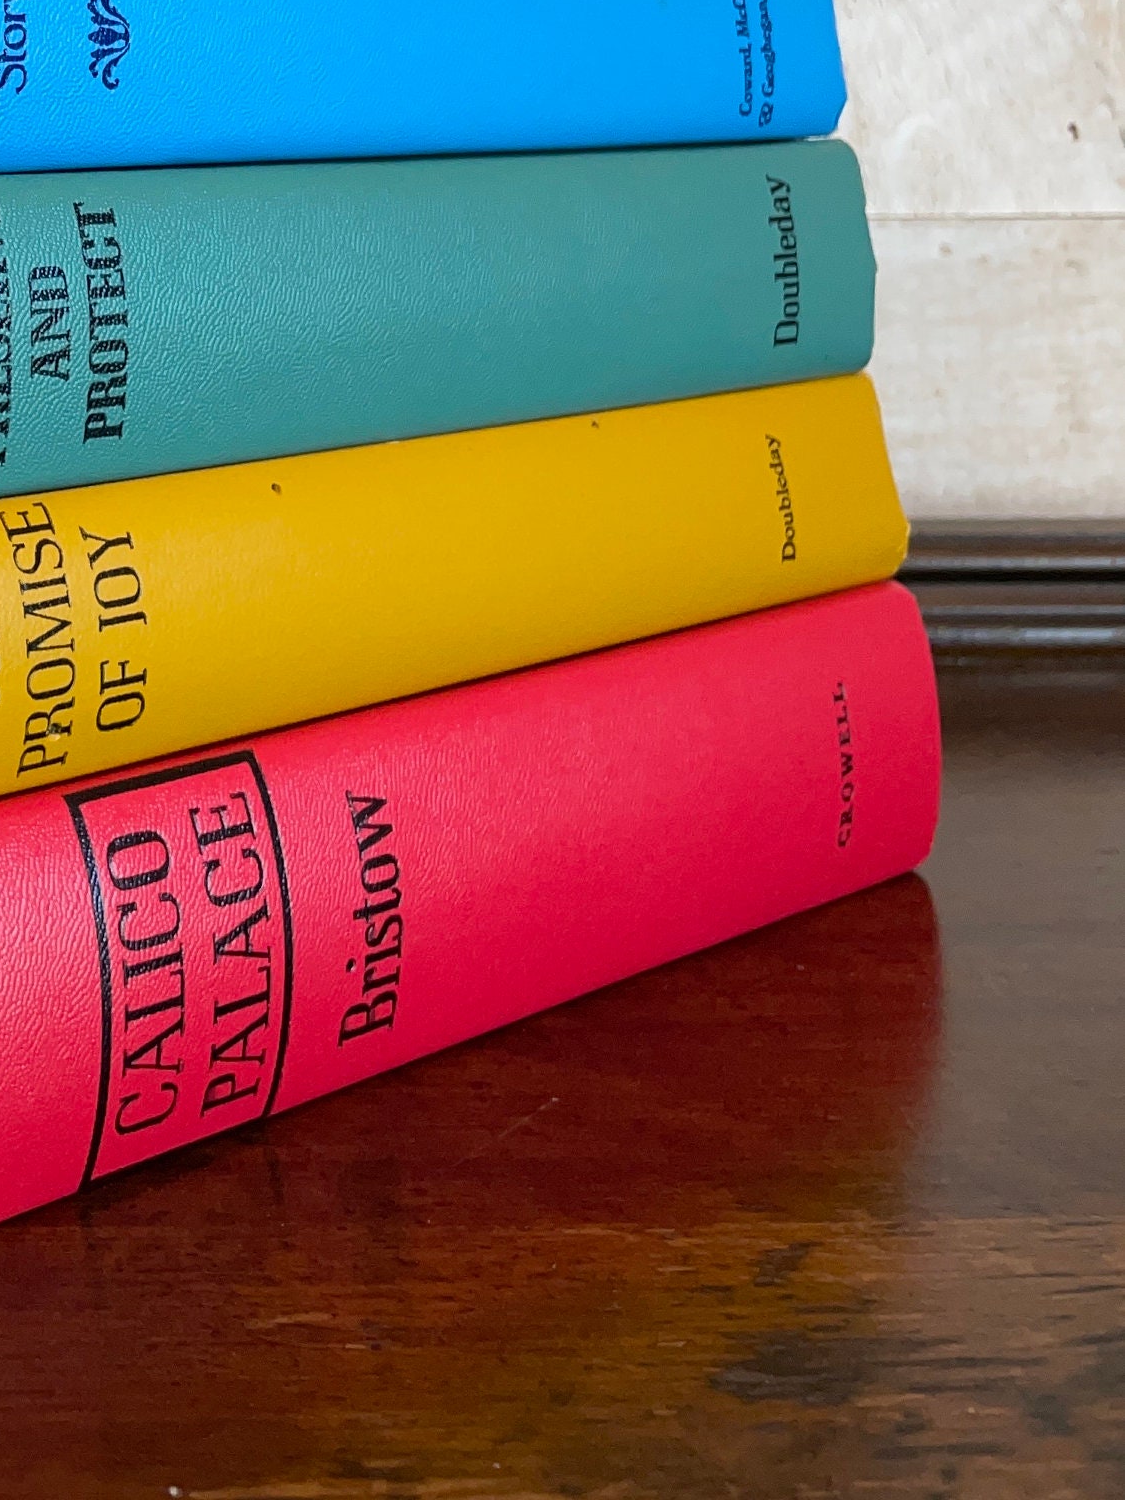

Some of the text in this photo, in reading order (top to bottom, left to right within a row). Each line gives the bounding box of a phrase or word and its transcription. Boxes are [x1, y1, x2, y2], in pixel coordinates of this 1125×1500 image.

[27, 265, 72, 382] AND
[72, 201, 129, 444] PROTECT
[765, 174, 801, 347] Doubleday
[765, 433, 797, 564] Doubleday
[78, 525, 149, 733] OF JOY
[832, 681, 855, 848] CROWELL
[105, 830, 186, 1137] CALICO
[188, 790, 272, 1119] PALACE
[338, 789, 403, 1048] Bristow
